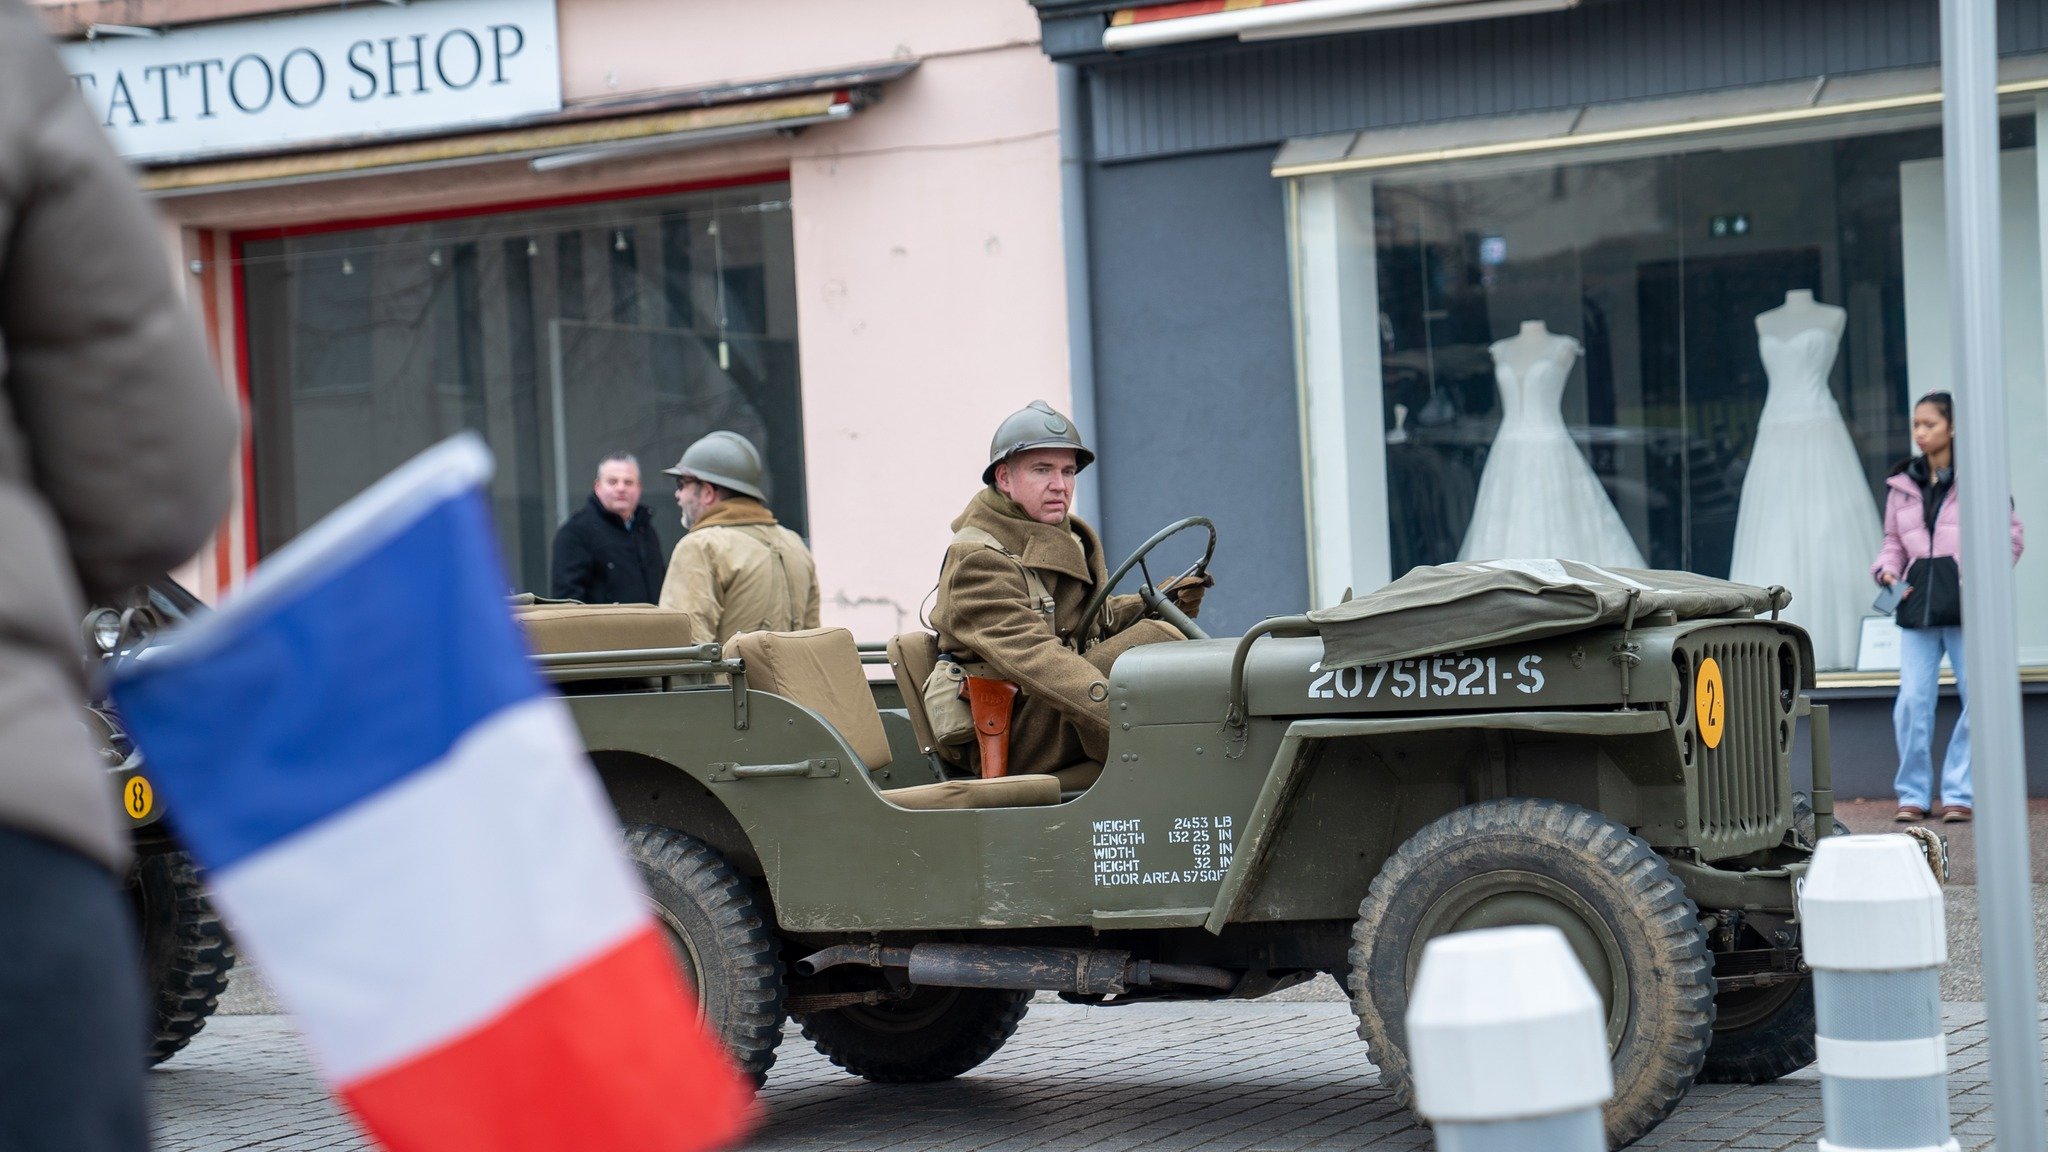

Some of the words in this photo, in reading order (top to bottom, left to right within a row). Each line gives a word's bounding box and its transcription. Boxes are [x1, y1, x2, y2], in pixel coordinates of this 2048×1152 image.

[68, 46, 326, 127] TATTOO
[346, 24, 525, 101] SHOP
[1308, 655, 1545, 698] 20751521-S
[1706, 679, 1716, 727] 2
[132, 782, 145, 813] 8
[1092, 819, 1141, 832] WEIGHT
[1174, 816, 1209, 830] 2453
[1214, 816, 1232, 828] LB
[1092, 832, 1145, 846] LENGTH
[1218, 829, 1232, 841] IN
[1093, 846, 1135, 860] WIDTH
[1193, 844, 1211, 856] 62
[1219, 842, 1233, 855] IN
[1093, 859, 1140, 873] HEIGHT
[1194, 857, 1212, 869] 32
[1219, 856, 1233, 868] IN
[1094, 873, 1139, 886] FLOOR
[1142, 871, 1181, 884] AREA
